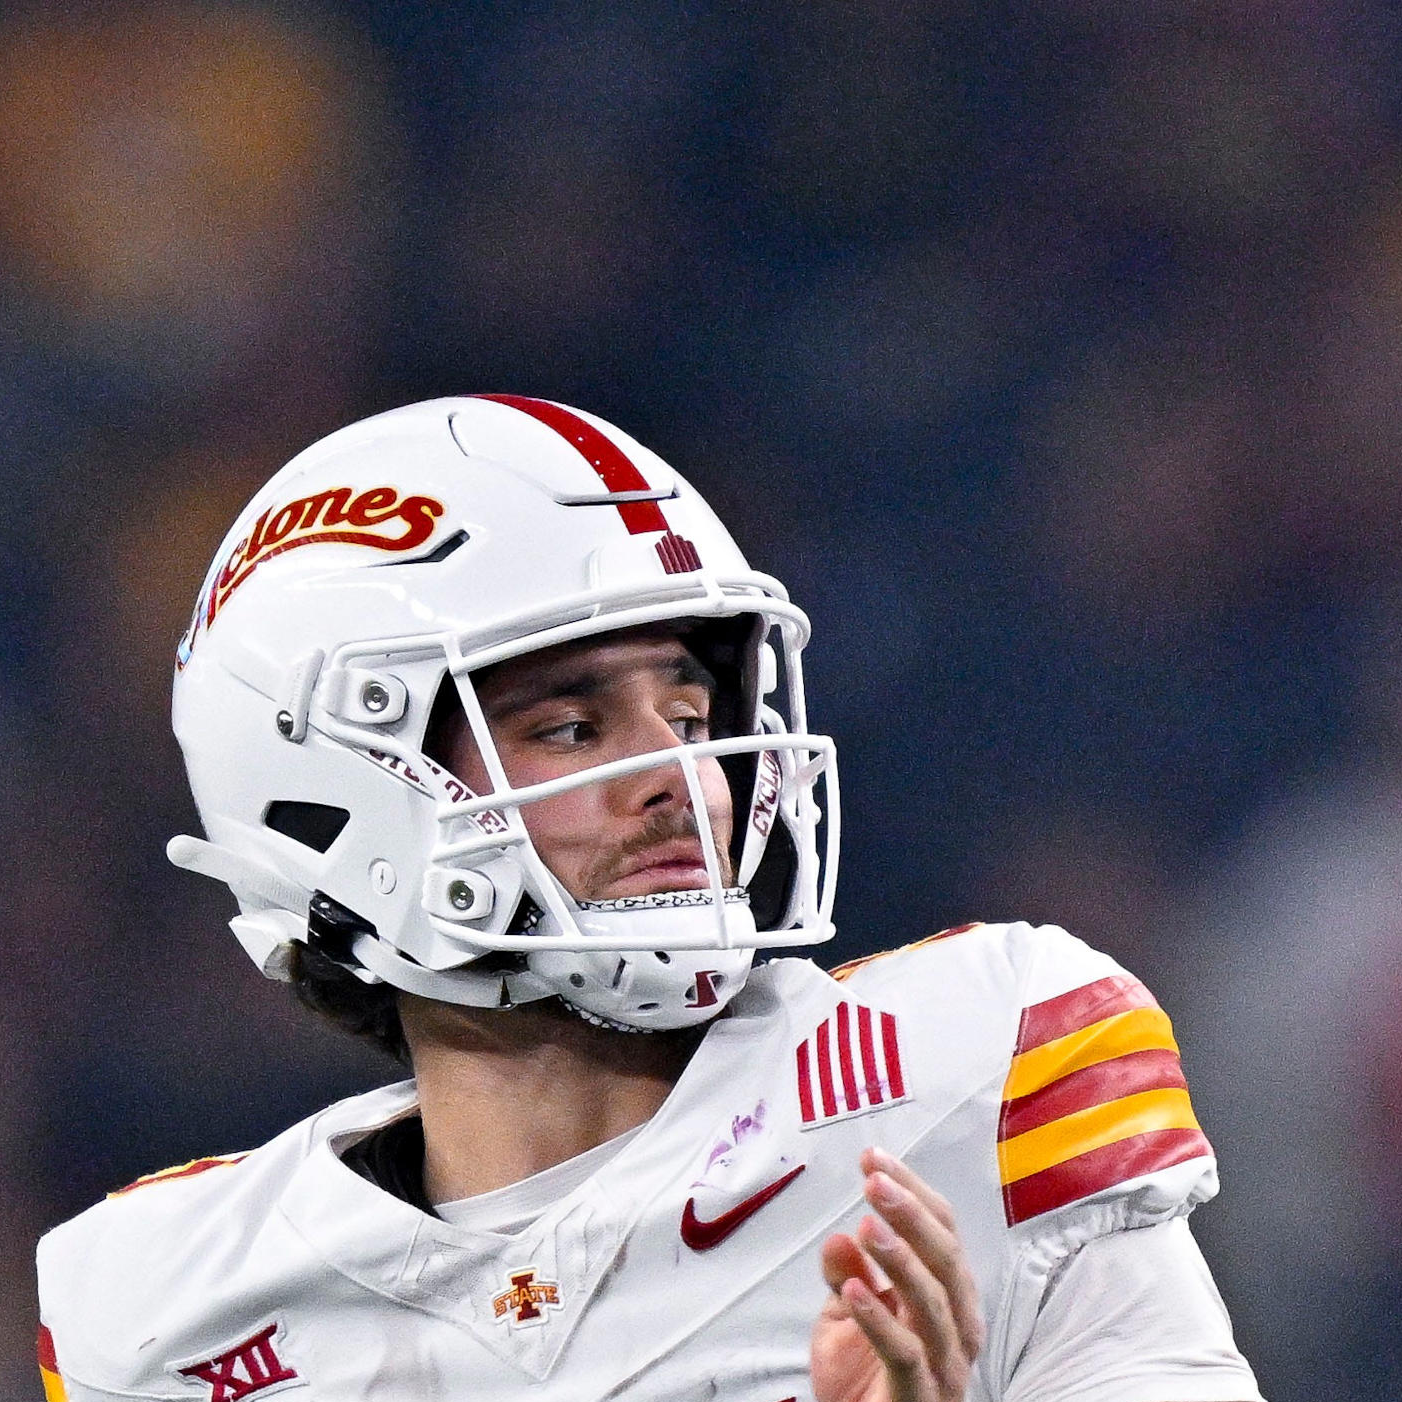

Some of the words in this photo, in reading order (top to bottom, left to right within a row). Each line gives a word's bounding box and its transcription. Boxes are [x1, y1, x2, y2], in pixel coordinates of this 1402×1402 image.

[198, 486, 444, 632] clones
[752, 750, 780, 837] CYCLO
[493, 1285, 560, 1318] STATE
